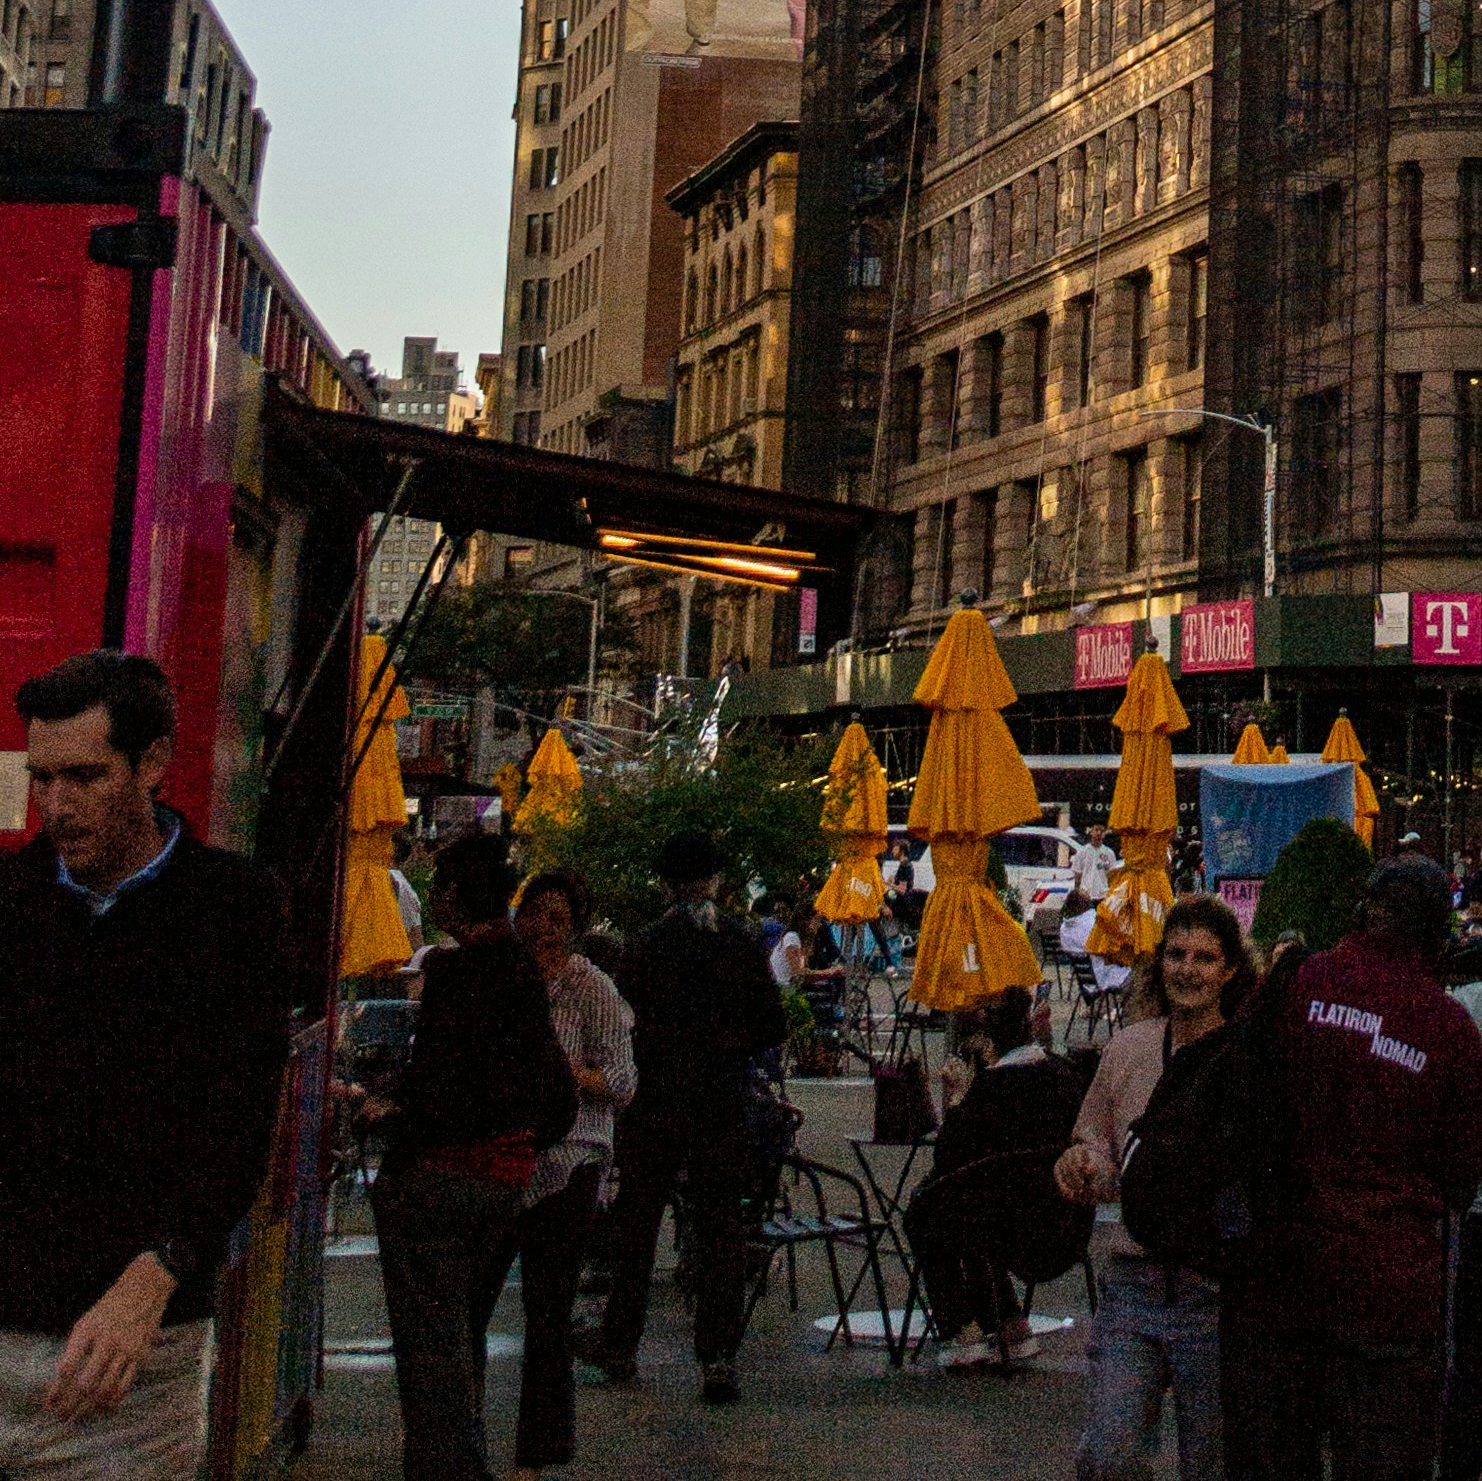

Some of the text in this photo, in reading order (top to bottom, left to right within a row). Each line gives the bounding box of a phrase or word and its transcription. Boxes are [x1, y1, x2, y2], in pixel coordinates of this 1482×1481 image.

[1425, 601, 1469, 654] T
[1308, 1000, 1383, 1034] FLATIRON
[1370, 1034, 1427, 1073] NOMAD
